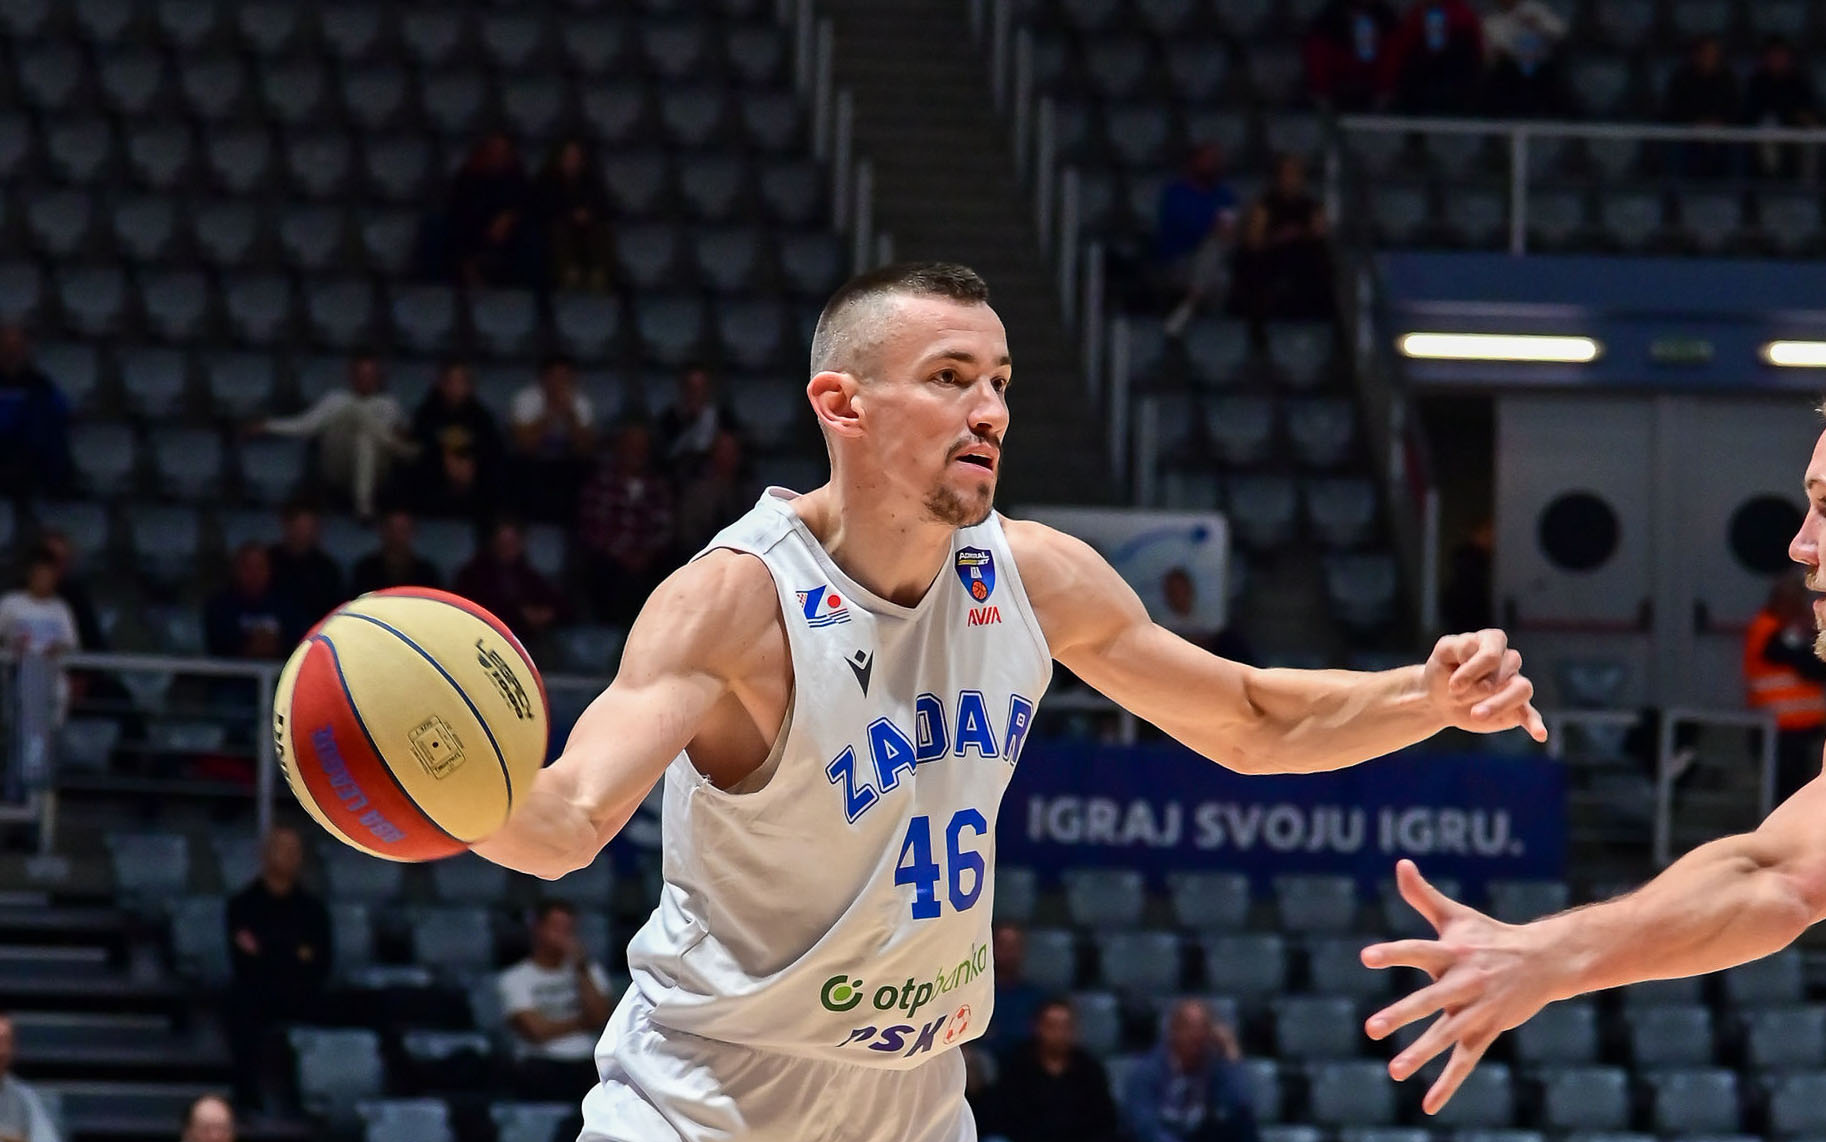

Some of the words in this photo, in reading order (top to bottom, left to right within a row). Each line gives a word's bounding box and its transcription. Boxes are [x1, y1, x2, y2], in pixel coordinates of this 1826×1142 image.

[967, 606, 1002, 627] AVIA
[824, 689, 1035, 825] ZADAR
[894, 808, 988, 920] 46
[1028, 795, 1183, 846] IGRAJ
[1194, 803, 1367, 852] SVOJU
[1376, 808, 1526, 856] IGRU.
